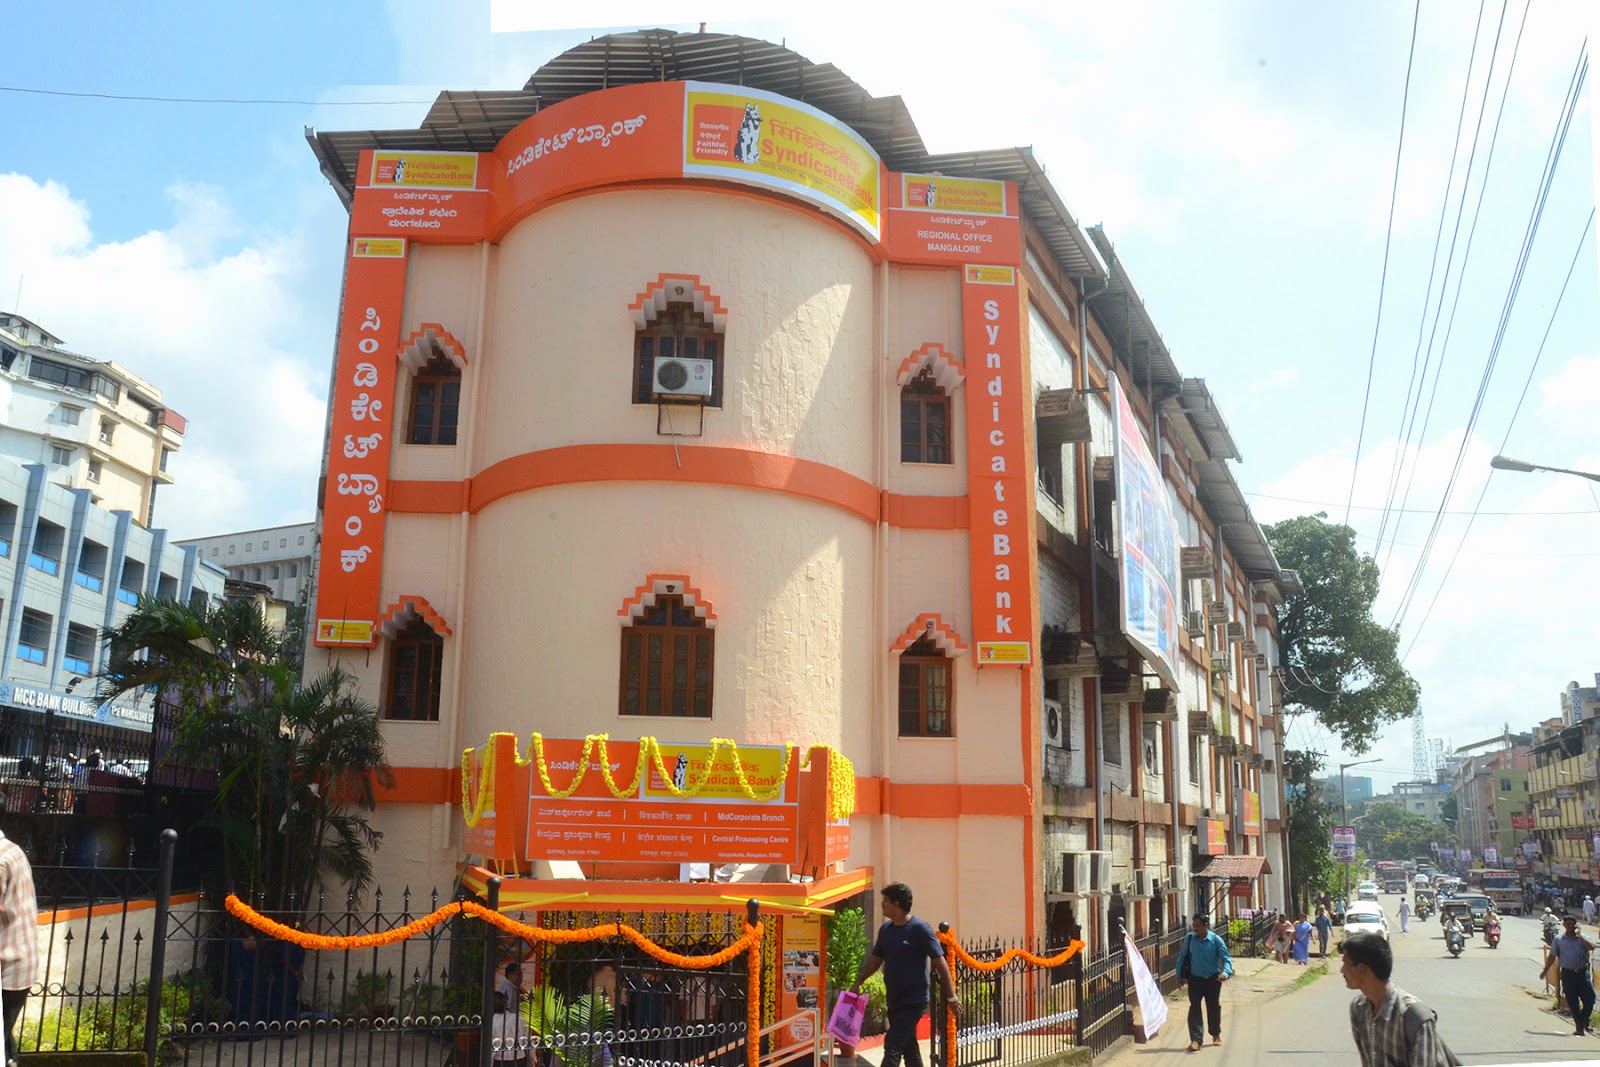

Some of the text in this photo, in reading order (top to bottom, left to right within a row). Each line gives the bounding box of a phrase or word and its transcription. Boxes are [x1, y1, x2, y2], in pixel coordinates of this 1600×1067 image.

[696, 147, 729, 156] Friendly
[405, 170, 473, 181] SyndicateBank
[761, 138, 874, 208] SyndicateBank
[937, 195, 1002, 207] SyndicateBank
[917, 230, 993, 243] REGIONAL OFFICE
[927, 243, 981, 254] MANGALORE
[14, 687, 36, 706] MCC
[36, 691, 61, 711] BANK
[717, 812, 785, 822] MidCorporate Branch
[712, 835, 789, 845] Central Processing Centre
